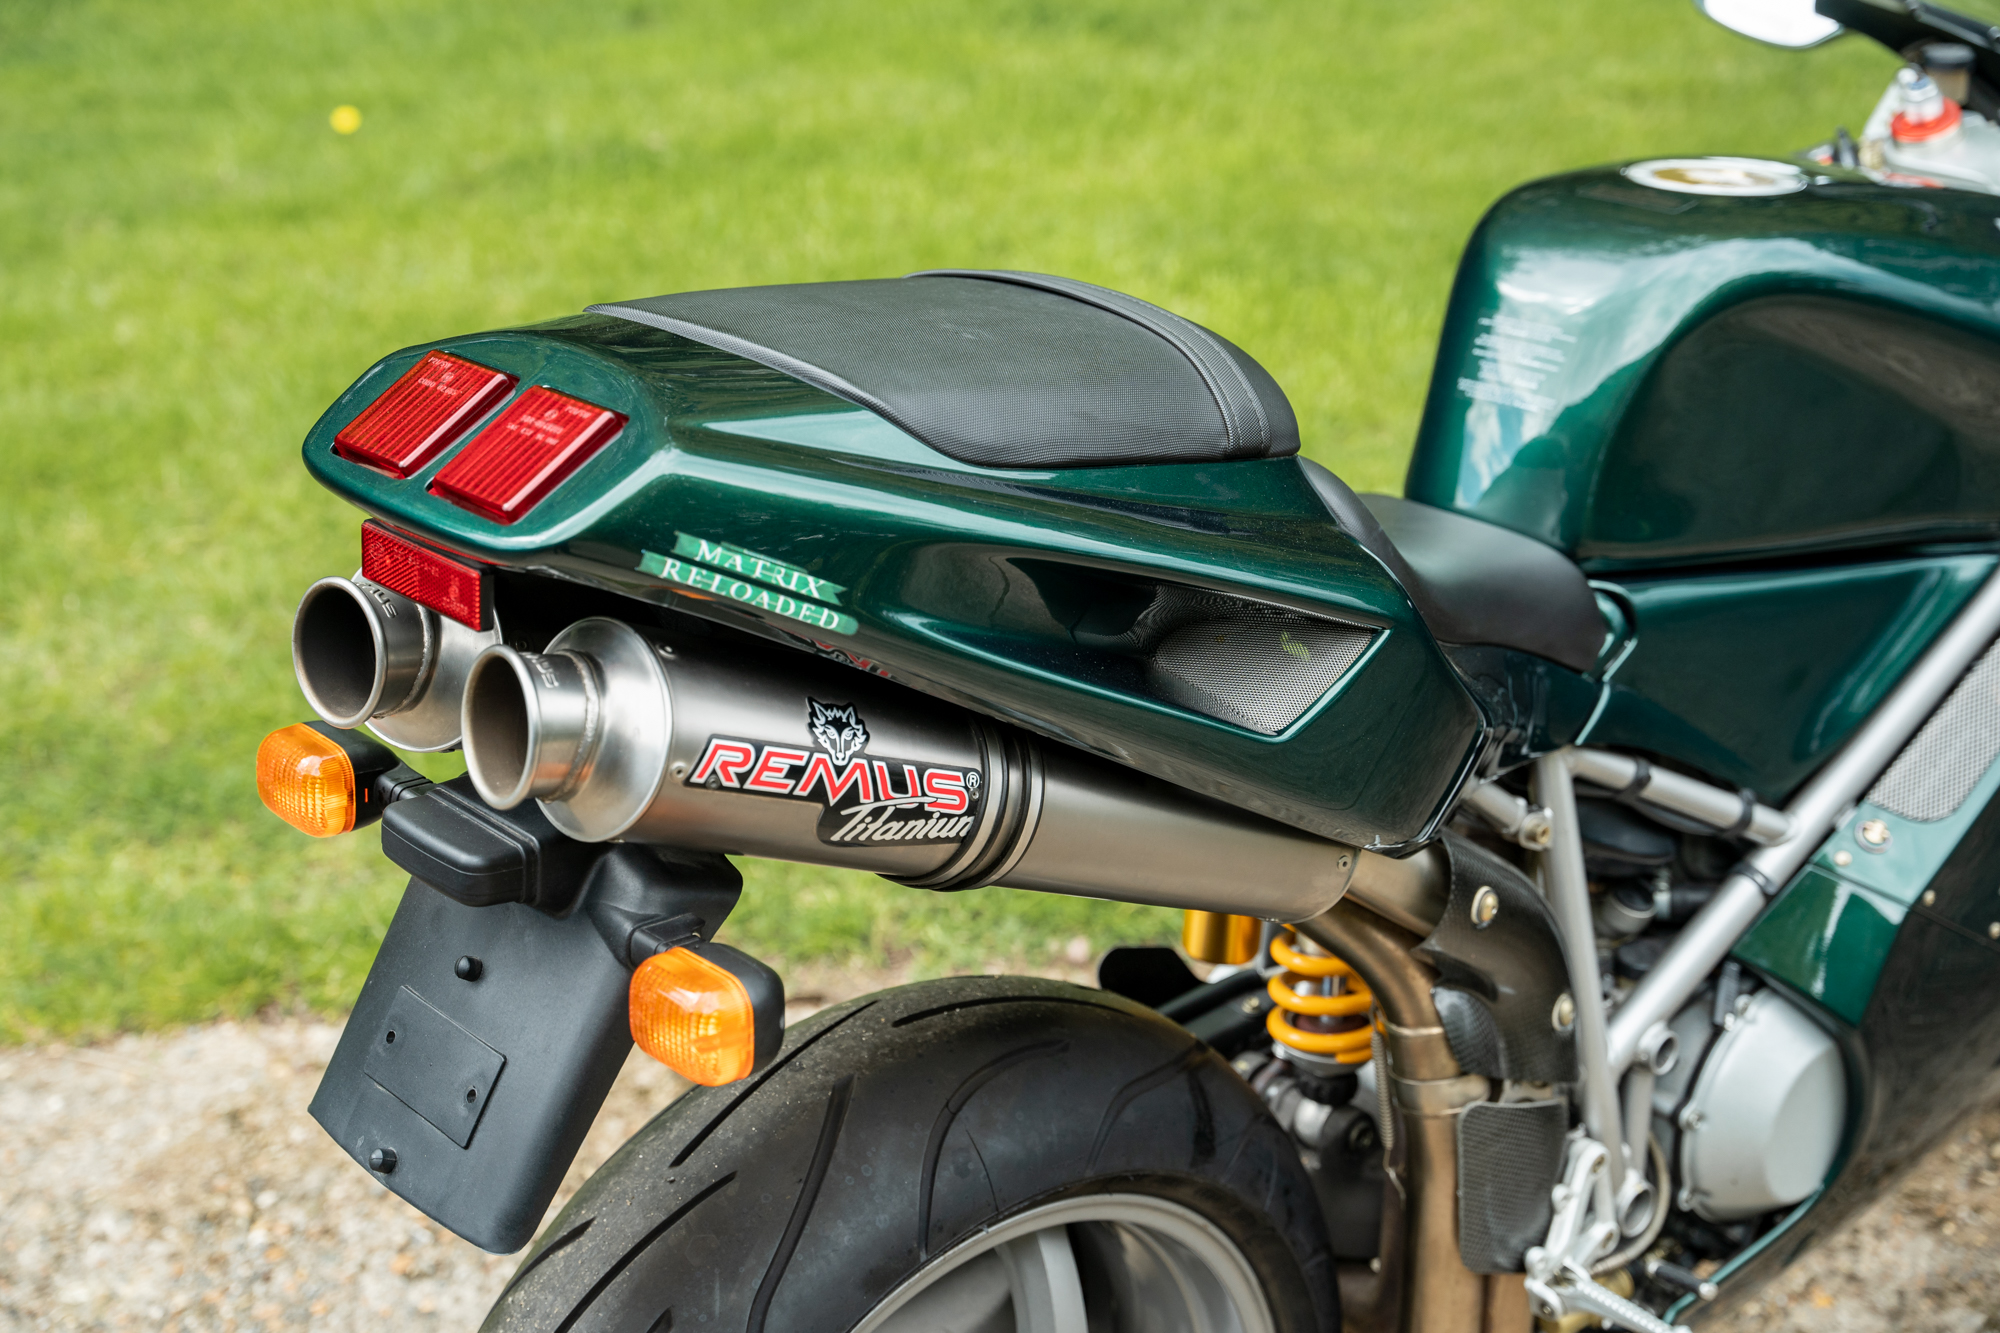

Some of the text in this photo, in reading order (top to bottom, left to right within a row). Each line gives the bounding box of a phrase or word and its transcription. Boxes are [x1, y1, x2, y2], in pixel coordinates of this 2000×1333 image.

[659, 558, 839, 629] RELOADED
[693, 538, 827, 599] MATRIX
[689, 738, 968, 813] REMUS
